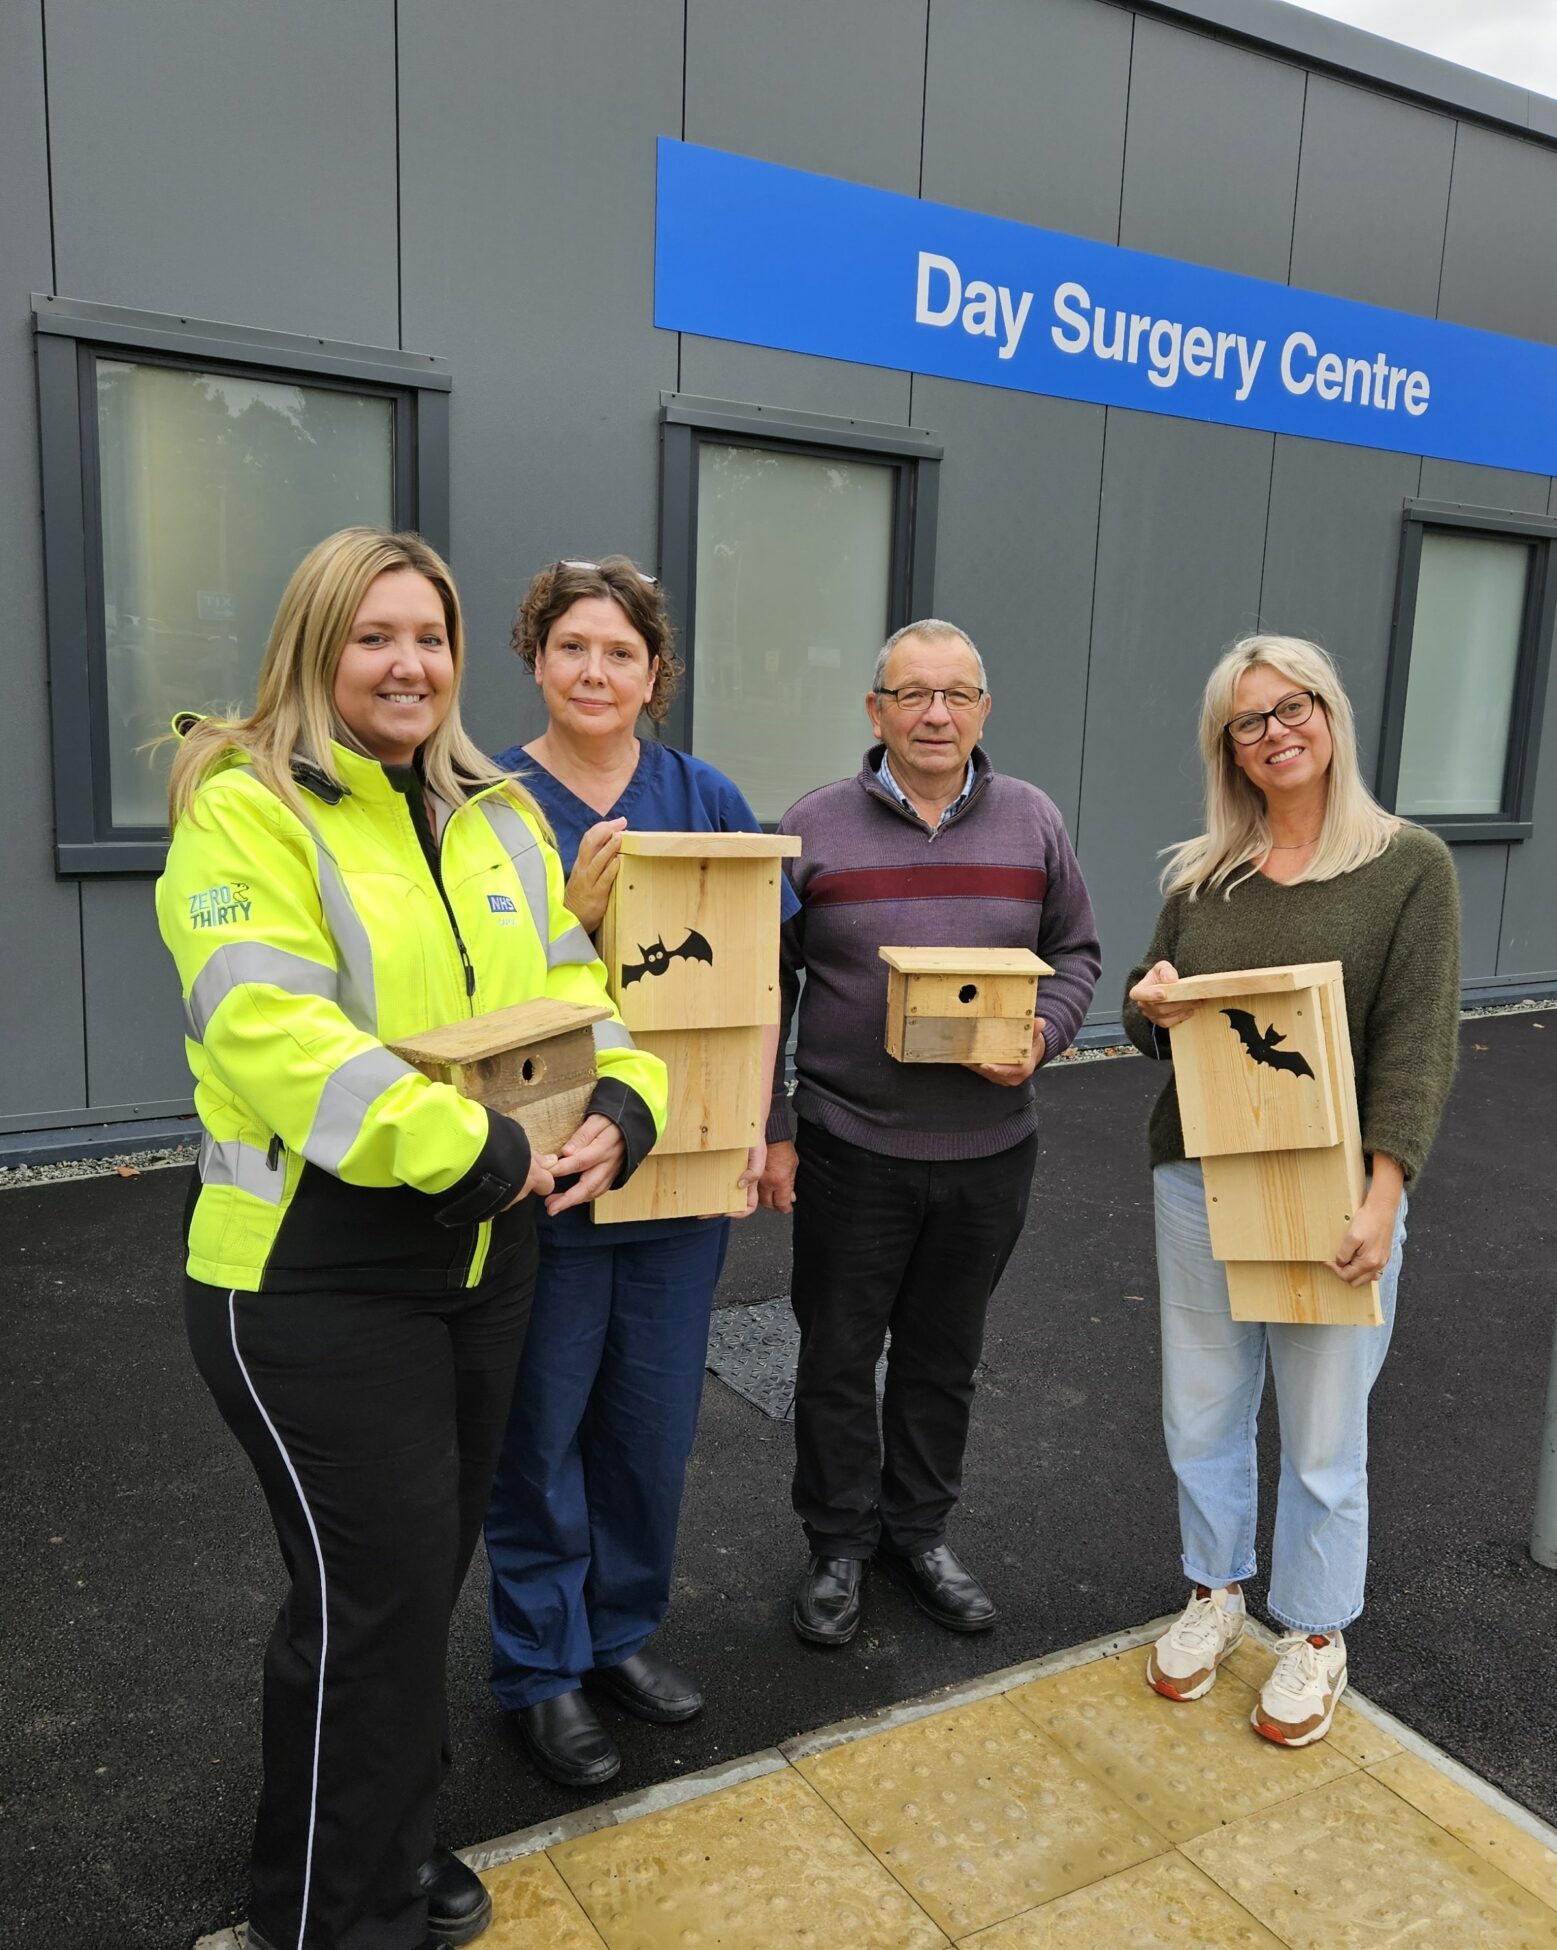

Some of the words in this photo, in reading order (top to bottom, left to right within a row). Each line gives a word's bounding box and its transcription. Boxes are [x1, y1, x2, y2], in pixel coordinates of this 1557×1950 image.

[915, 251, 1034, 360] Day
[1051, 282, 1266, 401] Surgery
[1280, 331, 1430, 416] Centre
[188, 886, 231, 914] ZERO
[490, 896, 515, 911] NHS
[190, 902, 252, 929] THIRTY
